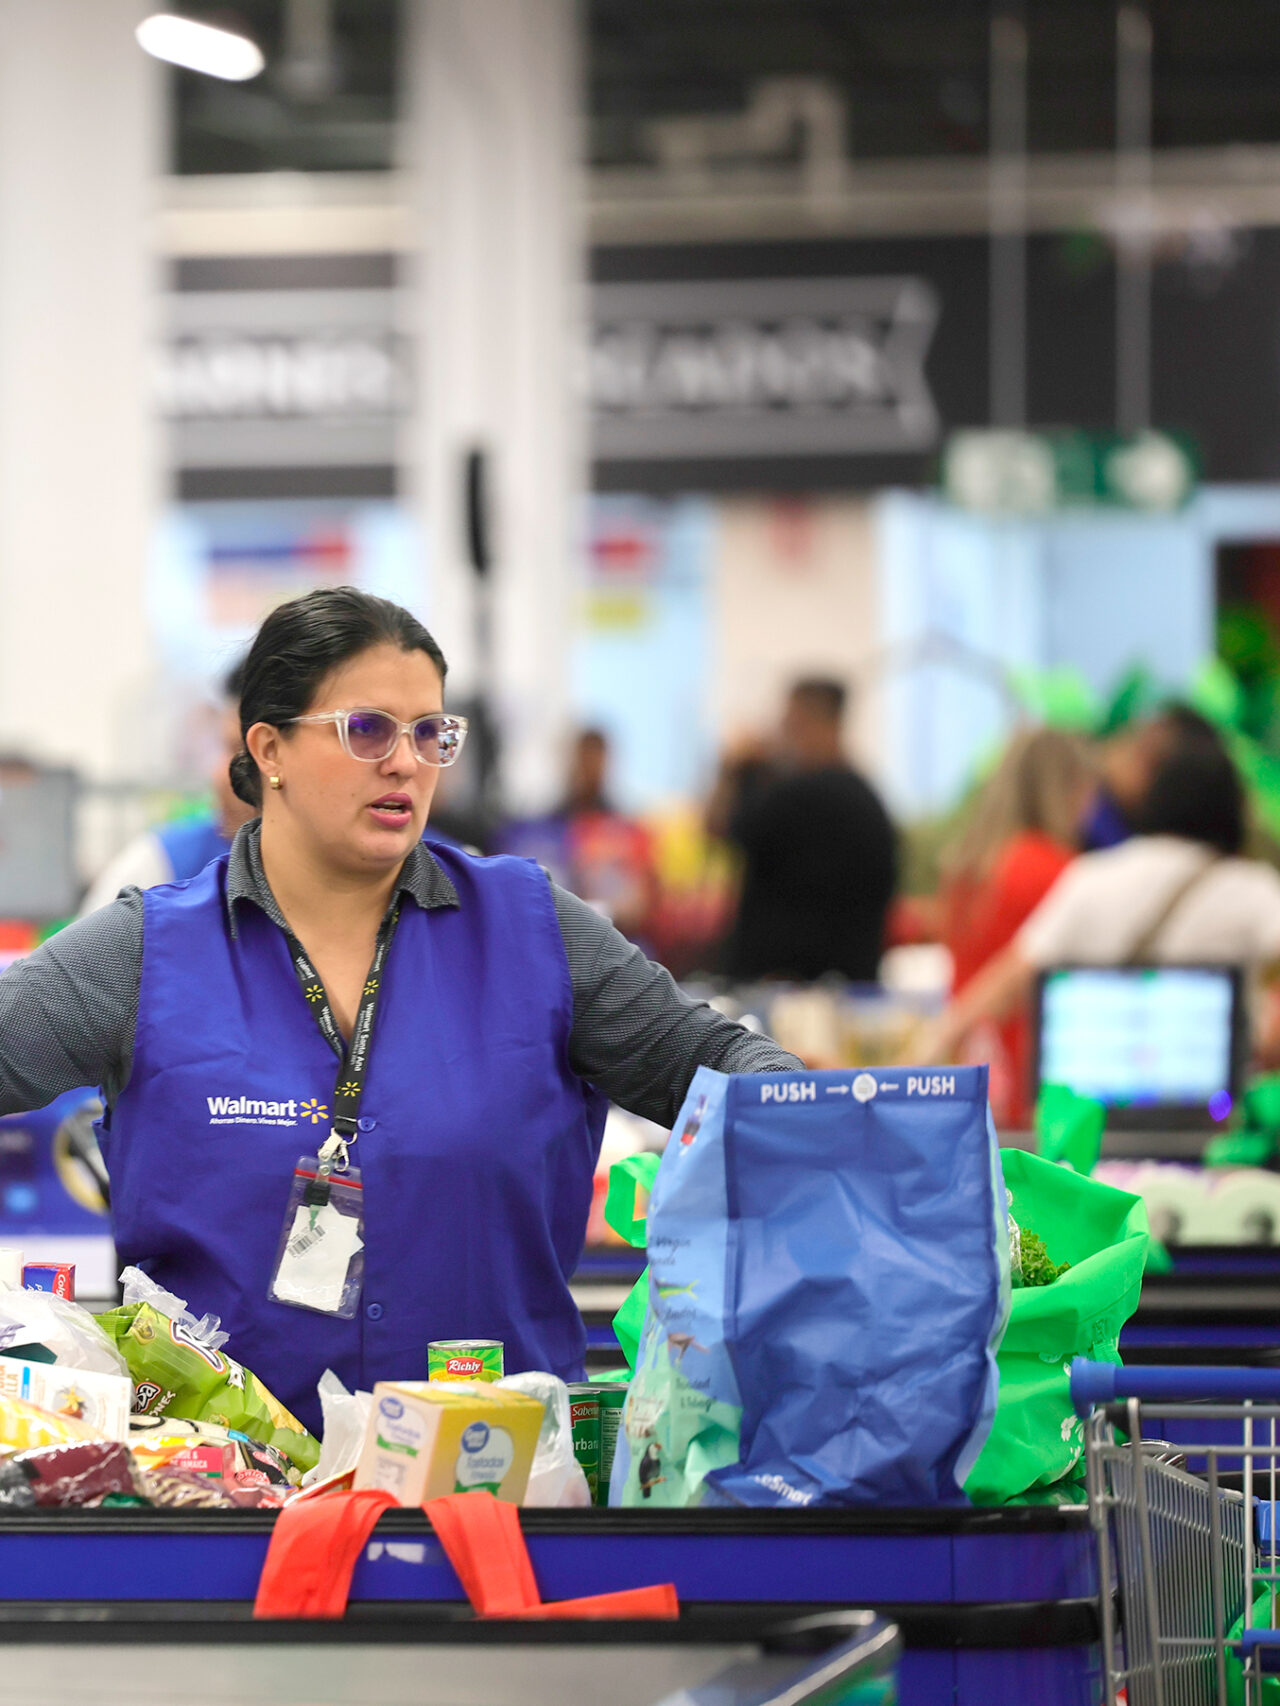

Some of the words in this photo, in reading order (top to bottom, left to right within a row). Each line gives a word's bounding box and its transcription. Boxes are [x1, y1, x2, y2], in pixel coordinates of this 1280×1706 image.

[362, 1001, 375, 1033] Walmart
[358, 1034, 370, 1055] Santa
[354, 1056, 365, 1072] Ana
[760, 1081, 816, 1103] PUSH
[907, 1075, 955, 1096] PUSH
[206, 1096, 298, 1117] Walmart
[56, 1274, 66, 1297] Colg
[448, 1359, 481, 1373] Richly
[572, 1437, 599, 1451] rban
